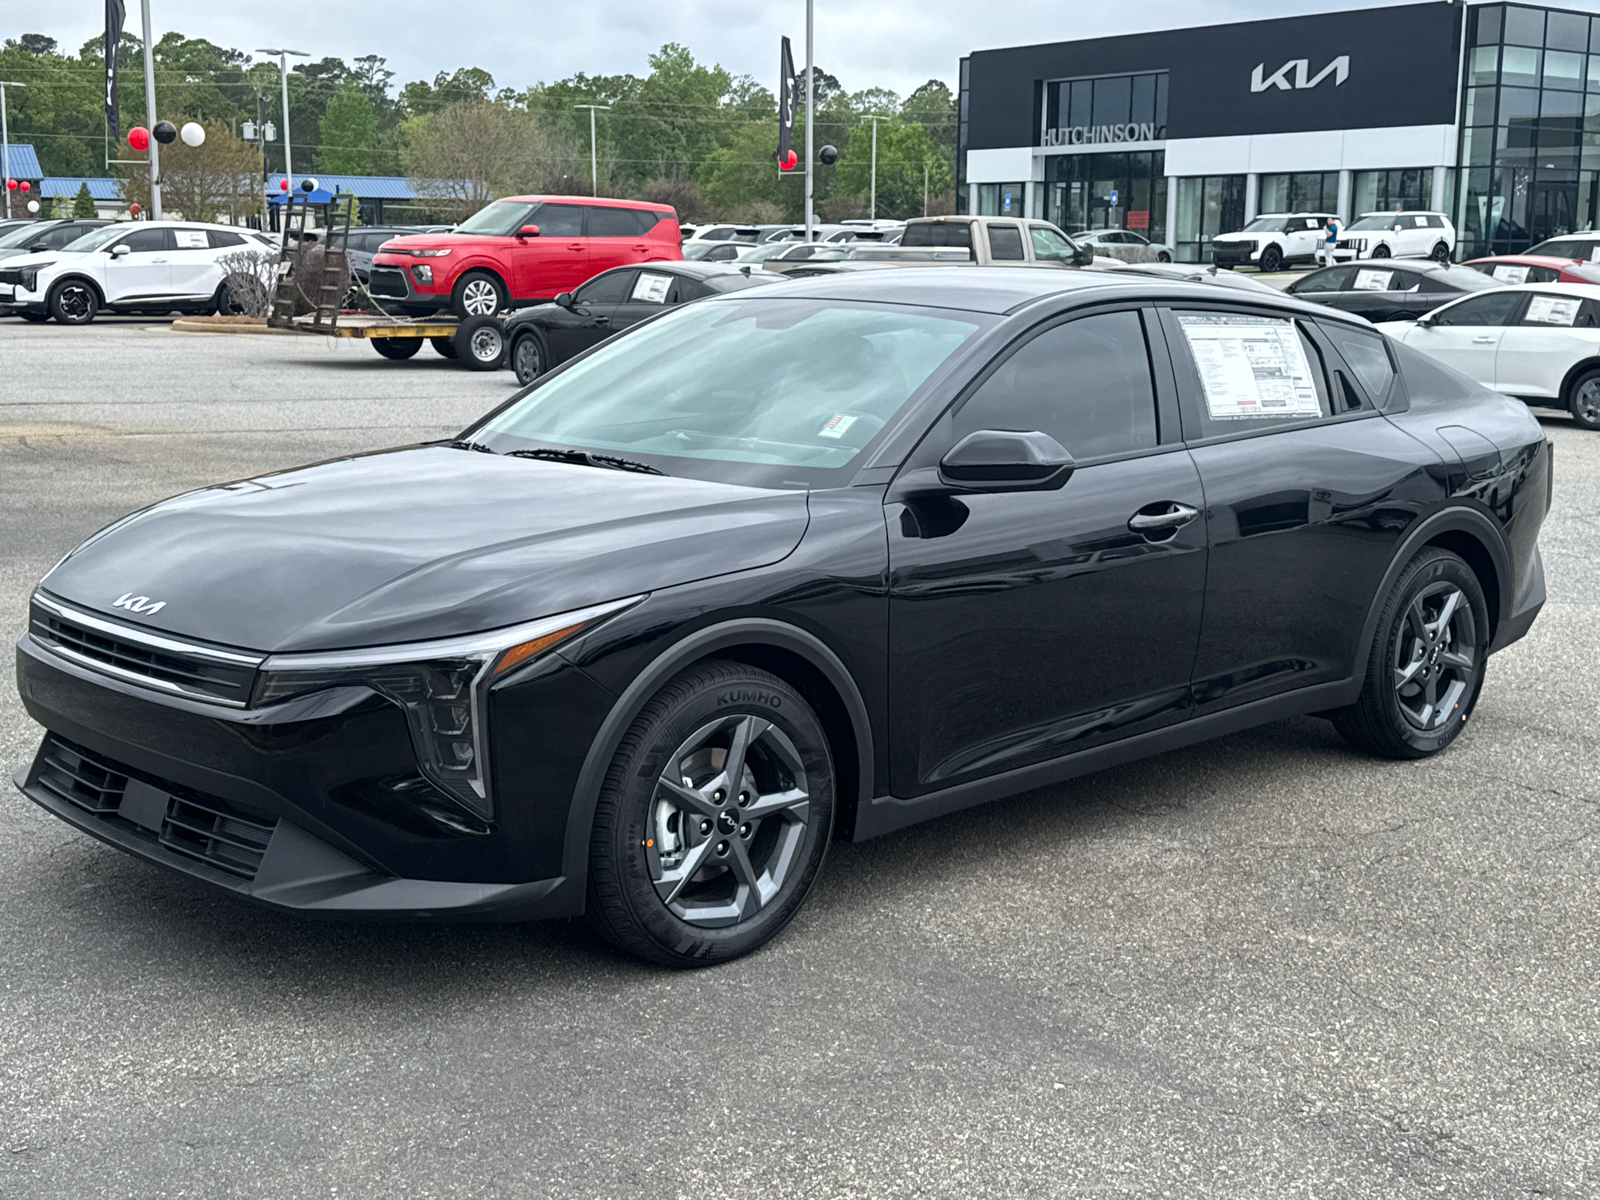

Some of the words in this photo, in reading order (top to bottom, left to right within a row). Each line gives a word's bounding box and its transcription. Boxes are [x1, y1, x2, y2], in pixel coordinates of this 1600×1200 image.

[1250, 55, 1350, 92] KIA
[1040, 122, 1155, 147] HUTCHINSON
[112, 592, 167, 616] KIA
[716, 689, 782, 708] KUMHO
